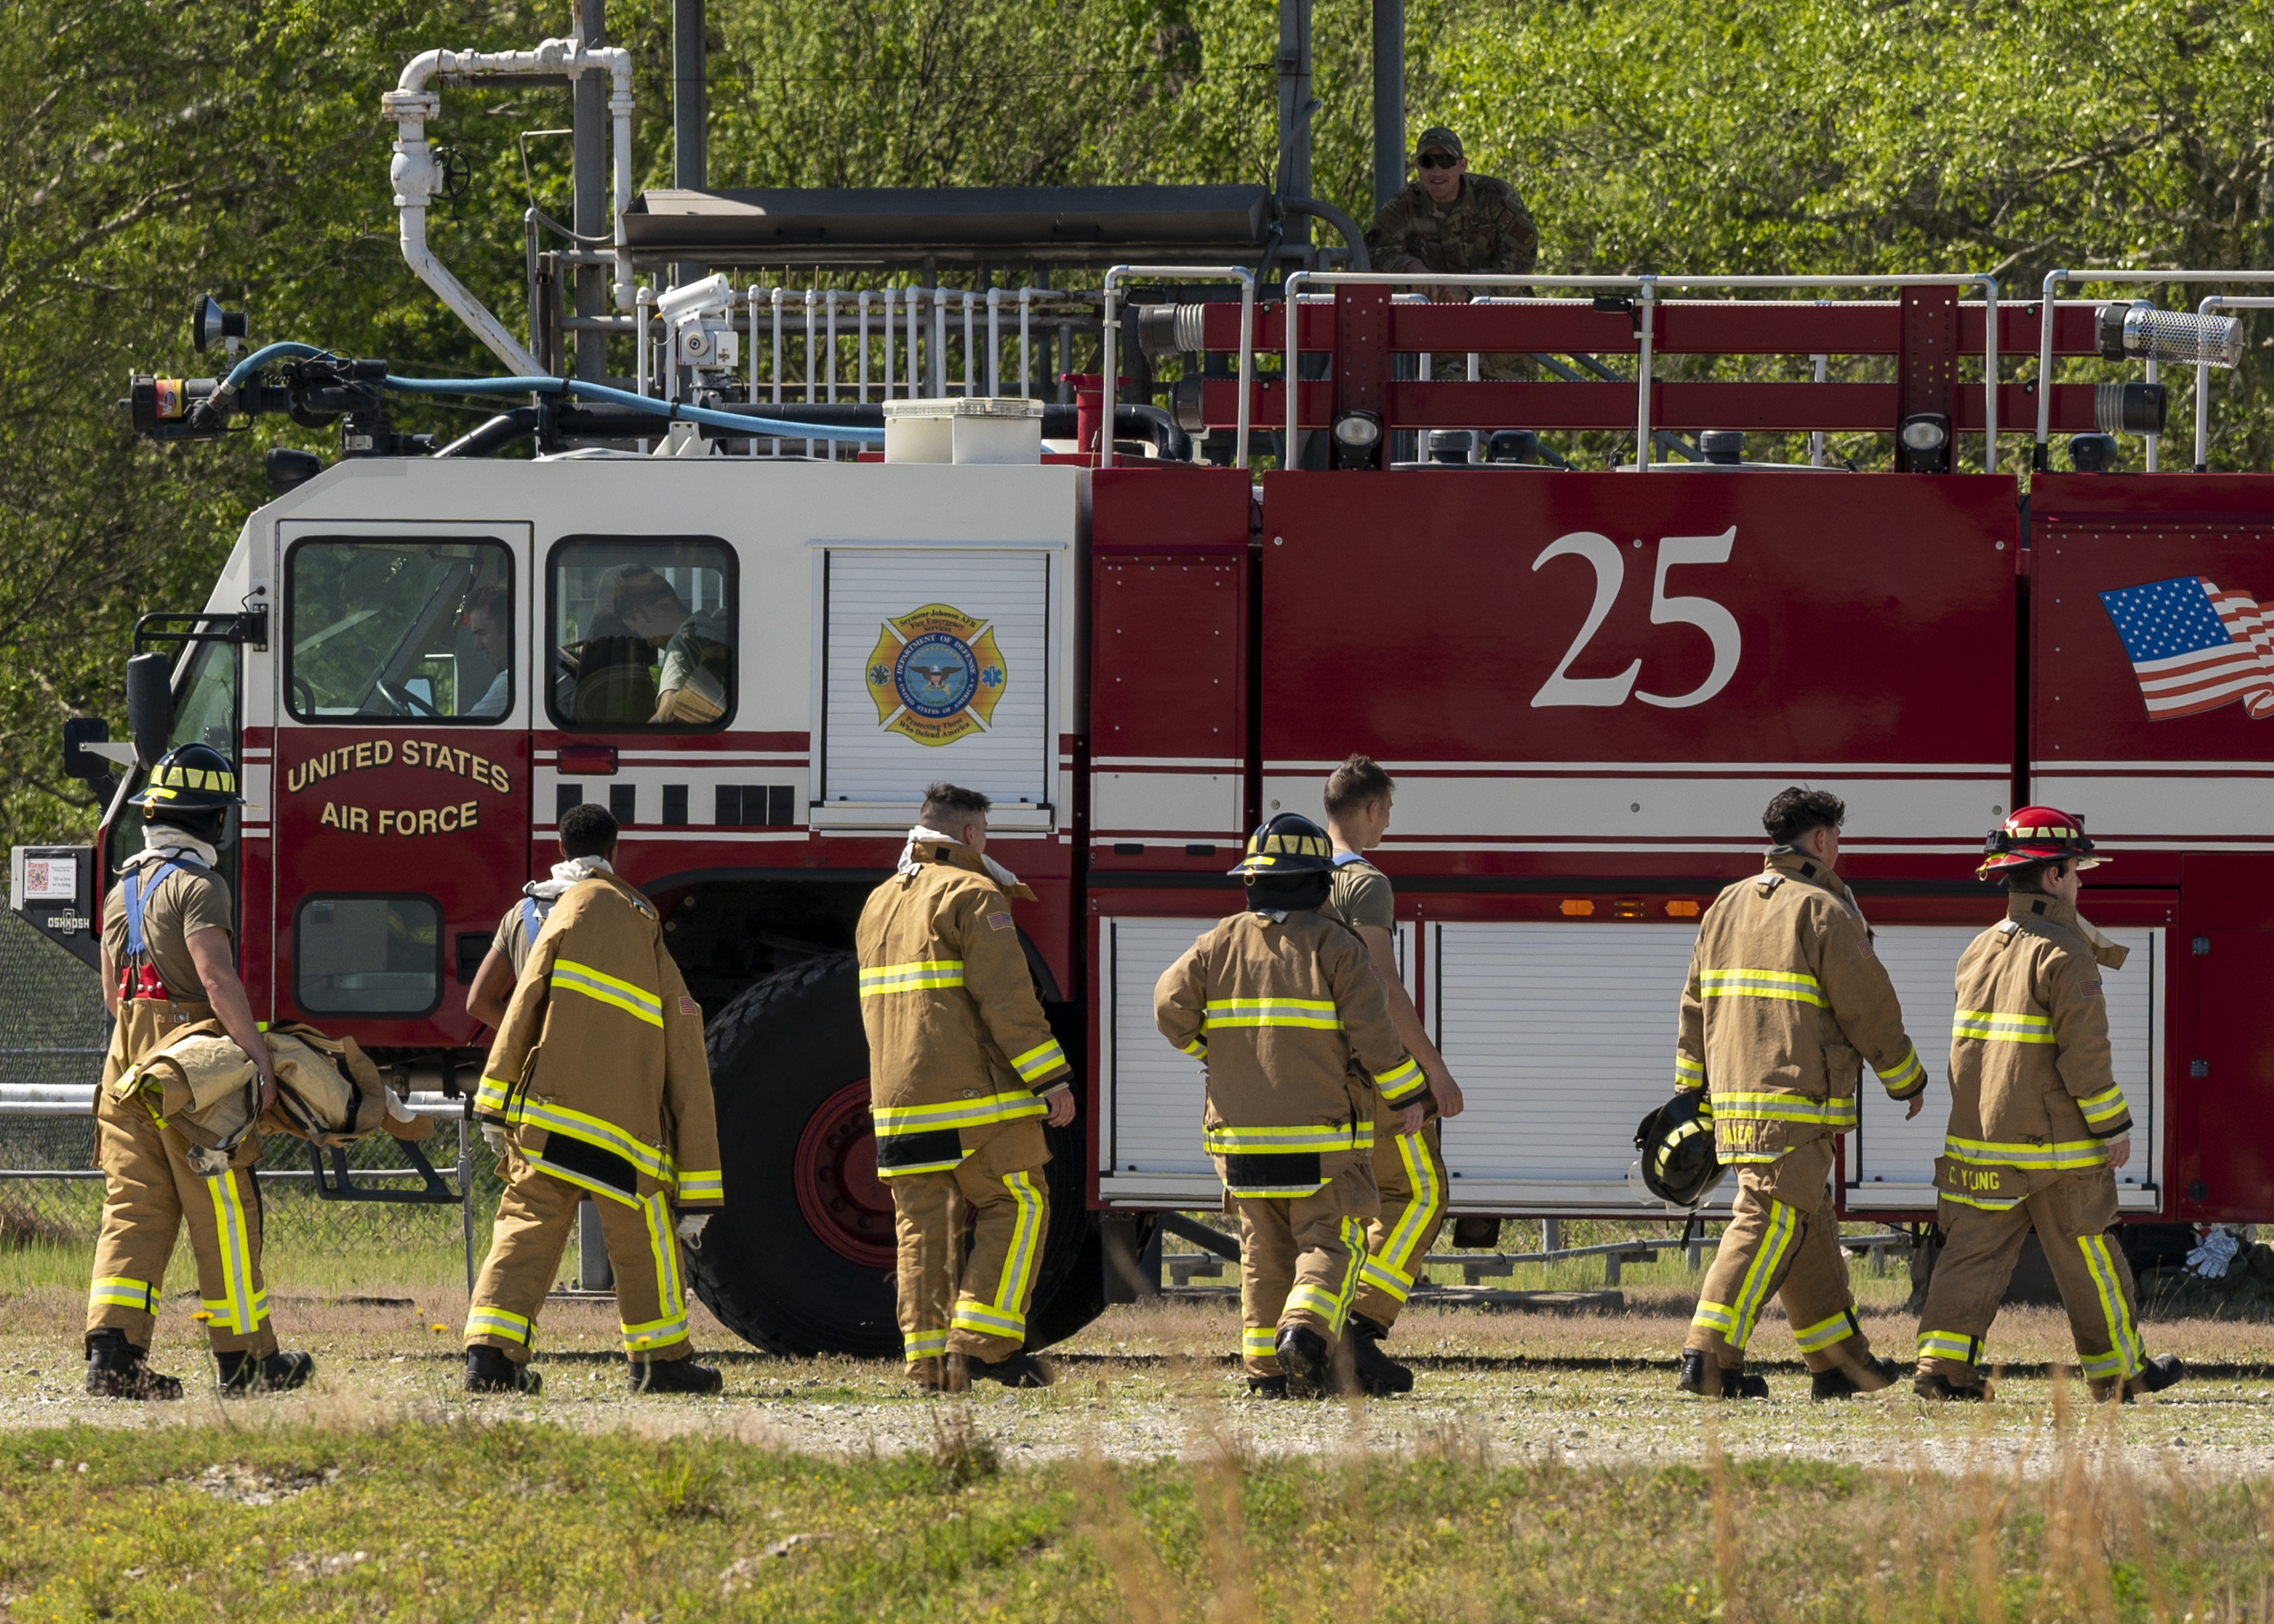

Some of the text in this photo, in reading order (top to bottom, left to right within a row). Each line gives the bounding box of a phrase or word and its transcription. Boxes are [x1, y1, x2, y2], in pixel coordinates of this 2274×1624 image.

[899, 610, 976, 628] Seymour Johnson AFB
[909, 618, 965, 631] Fire Emergency
[1530, 524, 1741, 708] 25
[896, 634, 936, 675] DEPARTMENT
[939, 635, 952, 643] OF
[953, 641, 976, 675] DEFENSE
[899, 683, 974, 714] UNITED STATES OF AMERICA
[899, 719, 970, 738] Who Defend America
[906, 715, 963, 731] Protecting Those
[288, 740, 510, 794] UNITED STATES
[320, 800, 478, 836] AIR FORCE
[47, 914, 89, 930] OSHKOSH
[1949, 1165, 1957, 1185] C.
